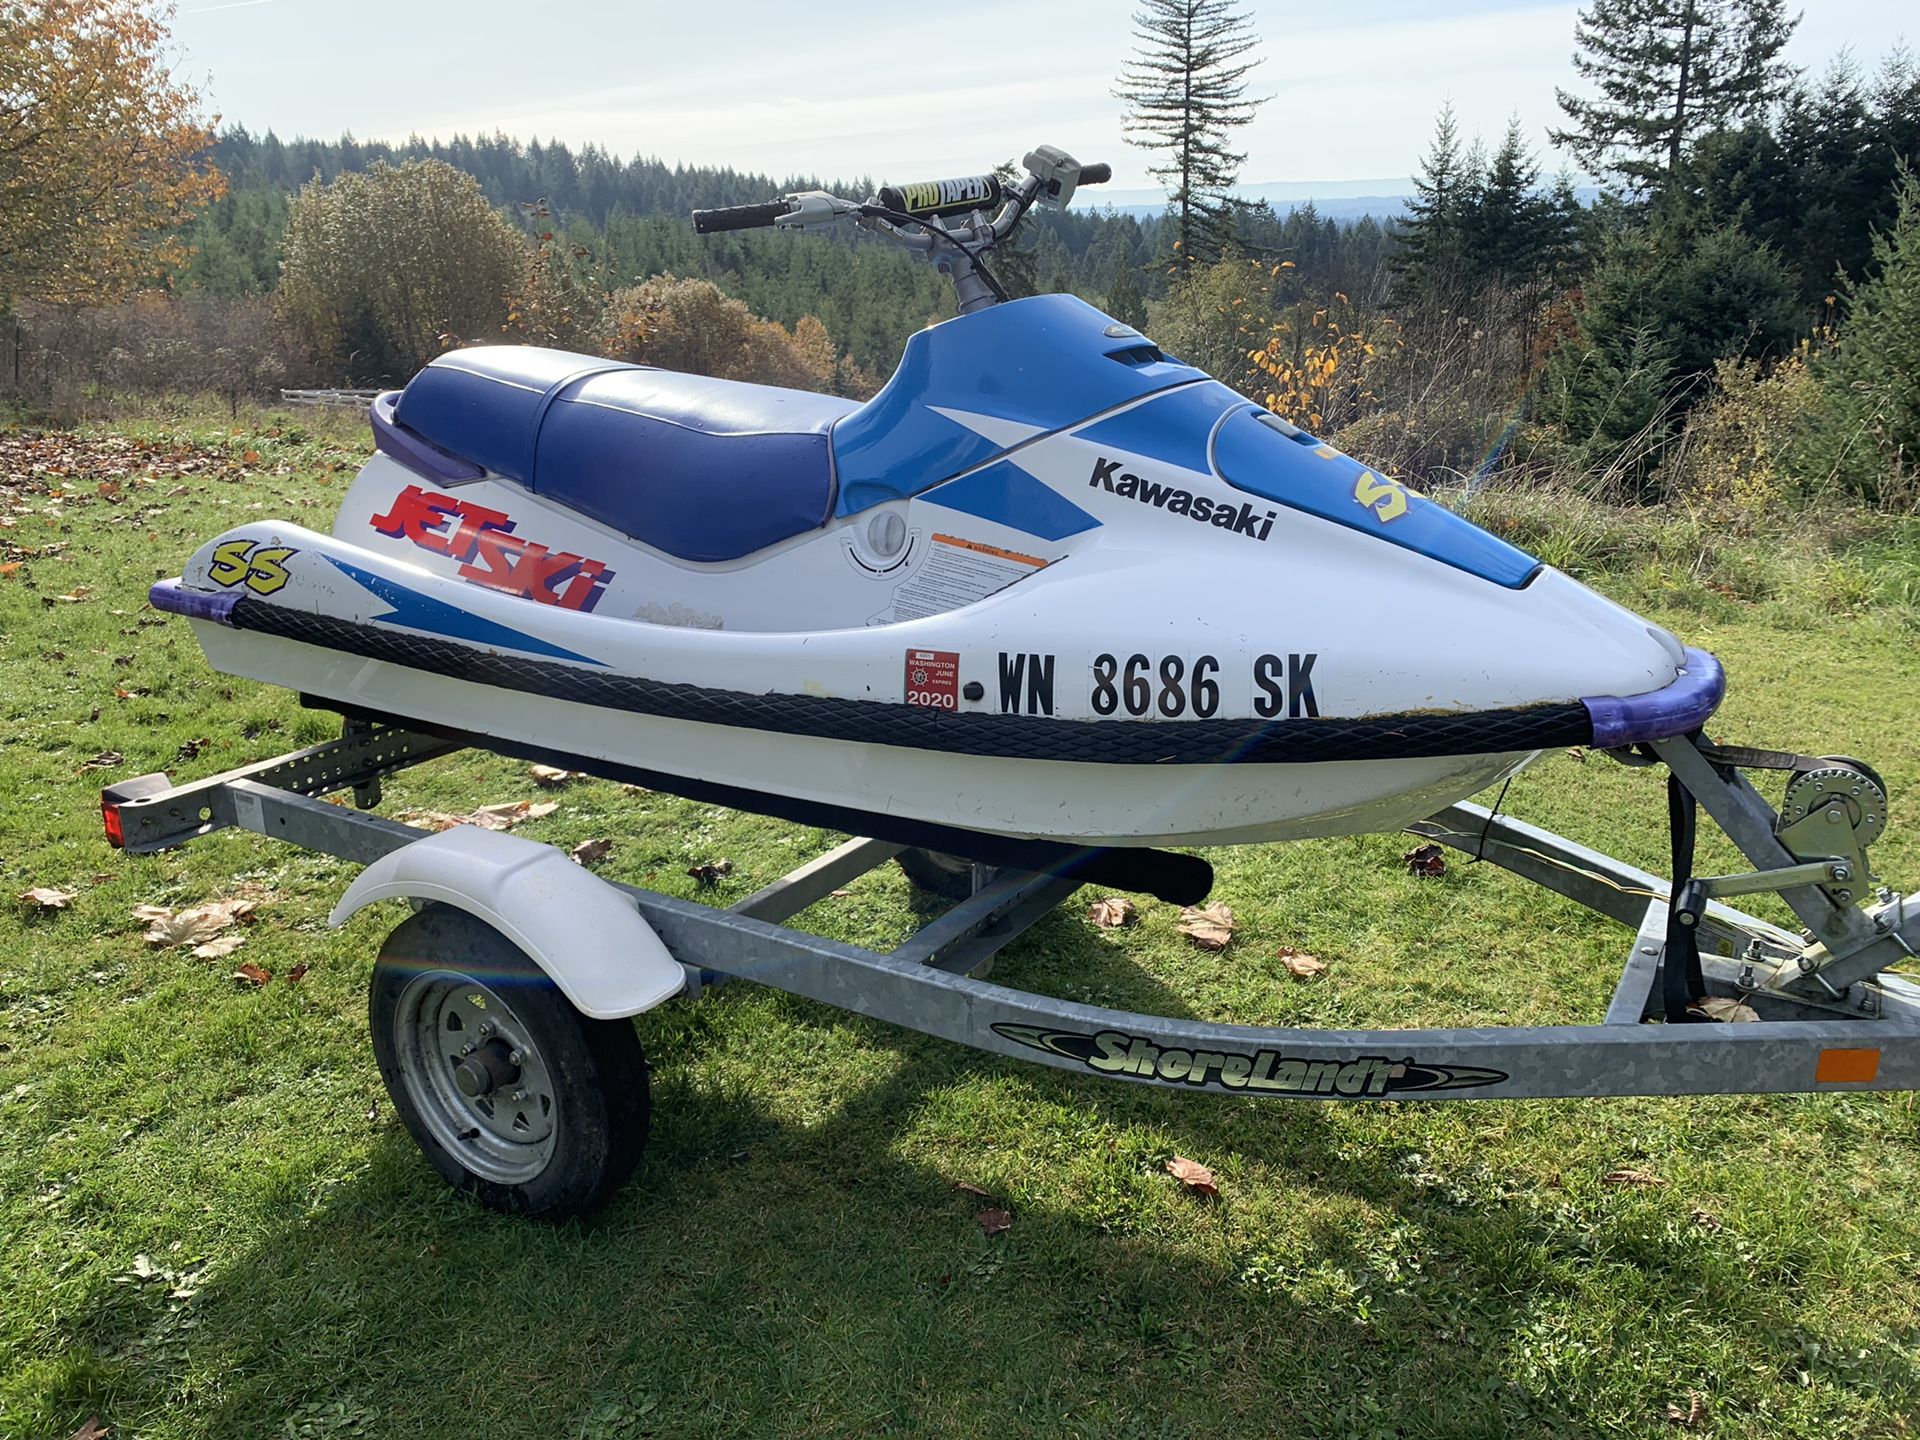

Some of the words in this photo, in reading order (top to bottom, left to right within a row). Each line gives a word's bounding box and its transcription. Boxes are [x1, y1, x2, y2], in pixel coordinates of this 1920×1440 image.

[905, 181, 939, 210] PRO
[1089, 456, 1278, 543] Kawasaki
[1353, 470, 1428, 523] S
[207, 540, 300, 596] SS
[909, 659, 955, 669] WASHINGTON
[999, 652, 1055, 716] WN
[1091, 653, 1220, 719] 8686
[1253, 653, 1320, 718] SK
[907, 690, 955, 708] 2020
